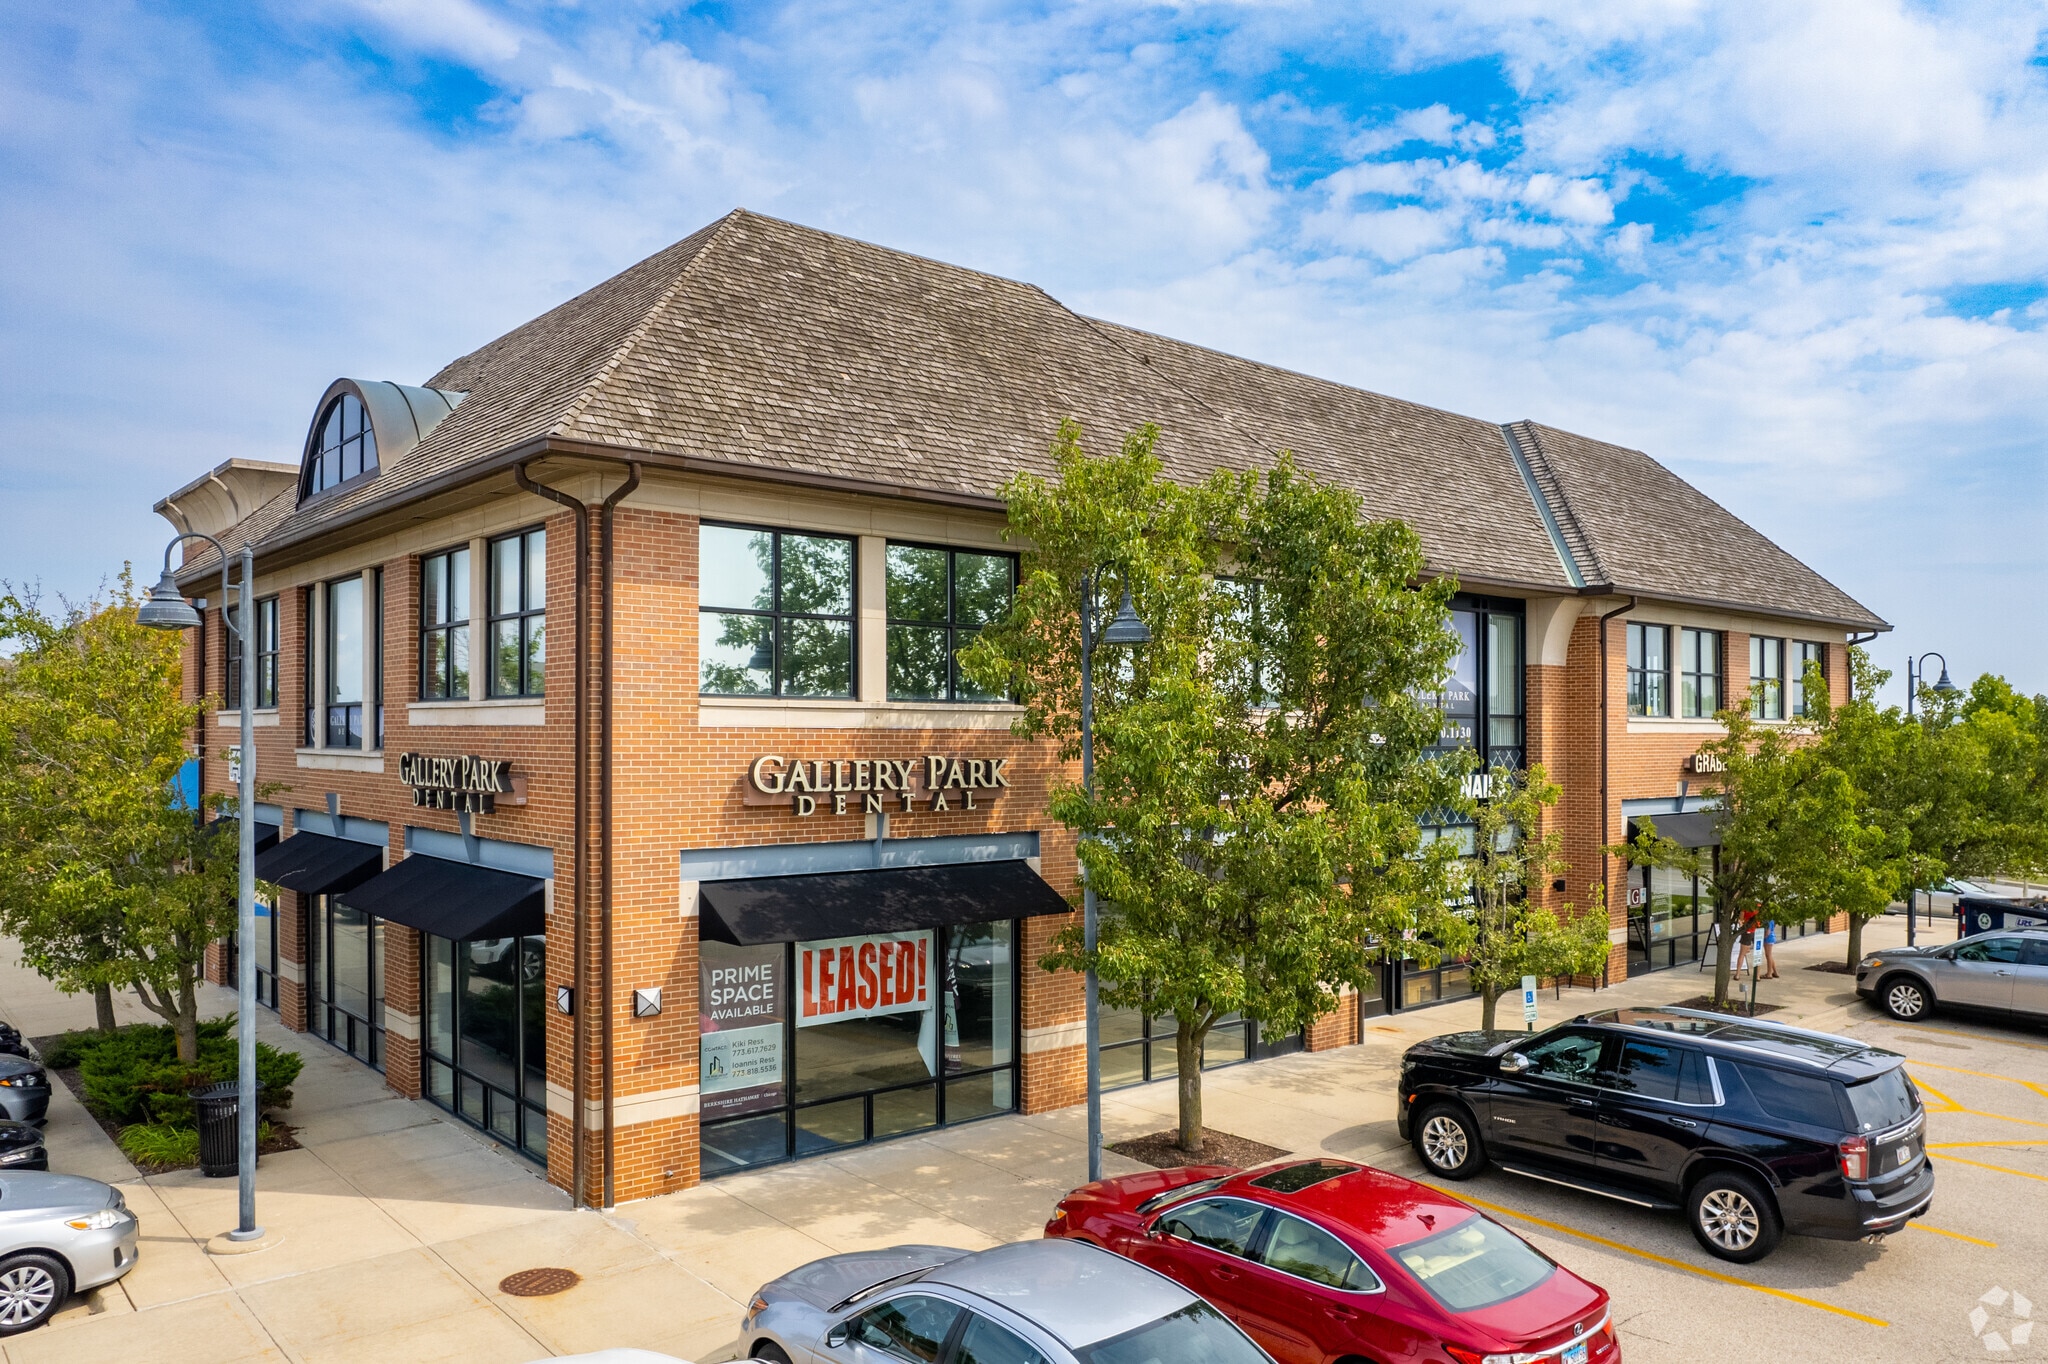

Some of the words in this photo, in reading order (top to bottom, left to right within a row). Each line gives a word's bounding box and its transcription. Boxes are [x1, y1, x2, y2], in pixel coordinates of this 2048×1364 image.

[1448, 691, 1470, 701] PARK
[399, 752, 458, 788] GALLERY
[462, 755, 503, 792] PARK
[752, 755, 917, 793] GALLERY
[926, 756, 1012, 790] PARK
[413, 788, 485, 815] DENTAL
[797, 791, 977, 816] DENTAL
[712, 964, 773, 986] PRIME
[803, 938, 927, 1017] LEASED!
[710, 983, 774, 1006] SPACE
[710, 1003, 774, 1020] AVAILABLE
[732, 1039, 746, 1048] Kiki
[748, 1038, 764, 1046] Ress
[732, 1043, 777, 1057] 773.617.7629
[760, 1056, 775, 1064] Ress
[732, 1064, 777, 1077] 773.818.5536
[703, 1098, 734, 1108] BERKSHIRE
